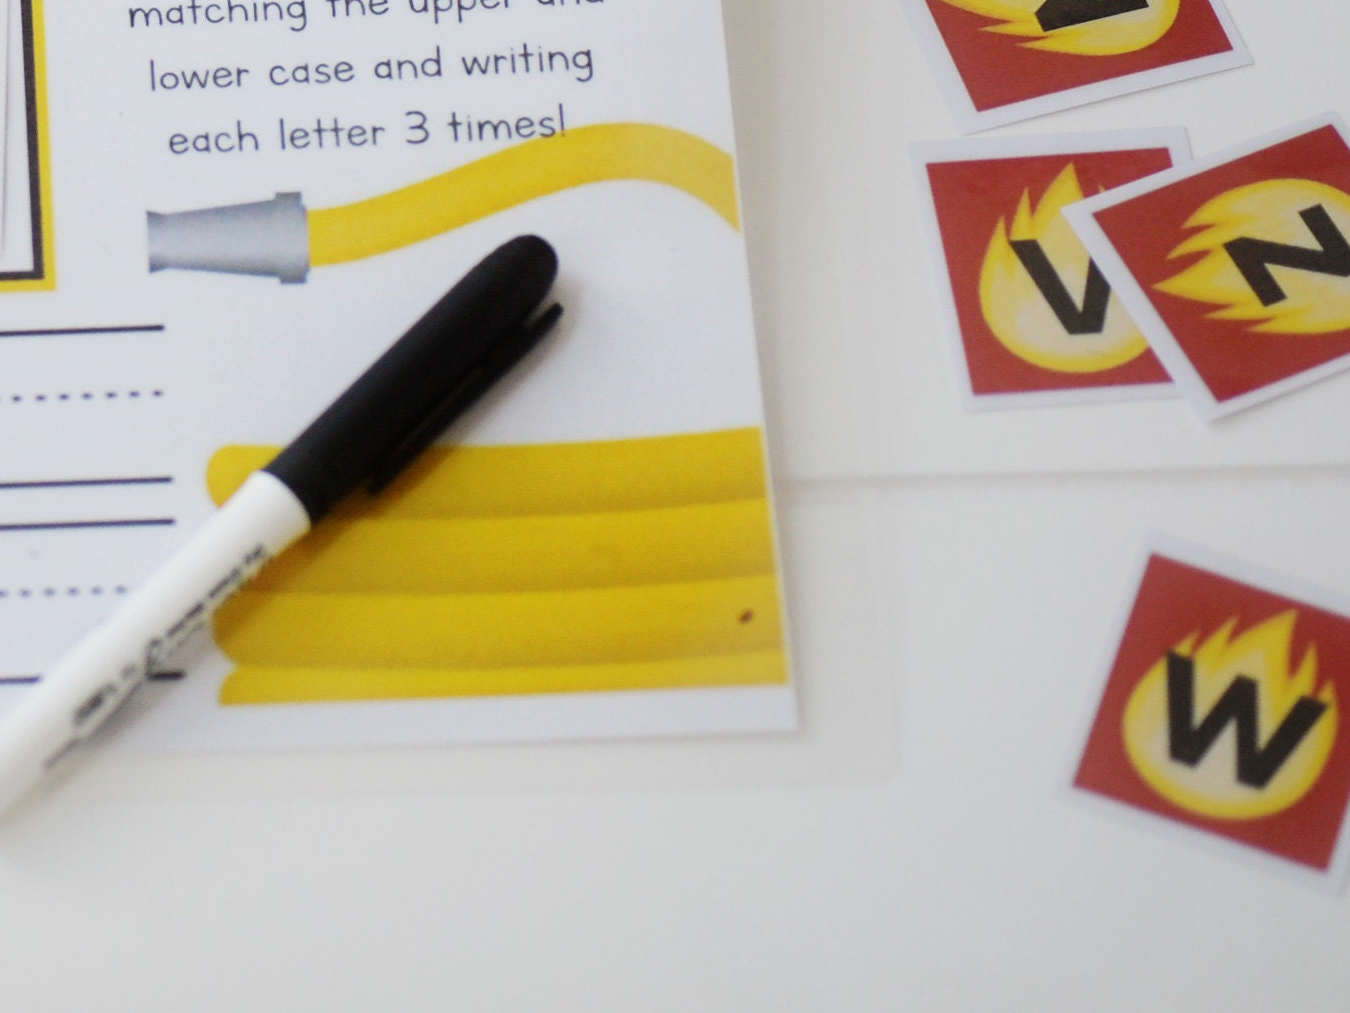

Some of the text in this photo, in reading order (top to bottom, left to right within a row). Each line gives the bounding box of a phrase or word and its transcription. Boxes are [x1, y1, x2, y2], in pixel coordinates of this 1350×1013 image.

[151, 44, 593, 90] lower case and writing
[170, 104, 564, 154] each letter 3 times!
[1163, 648, 1328, 790] W
